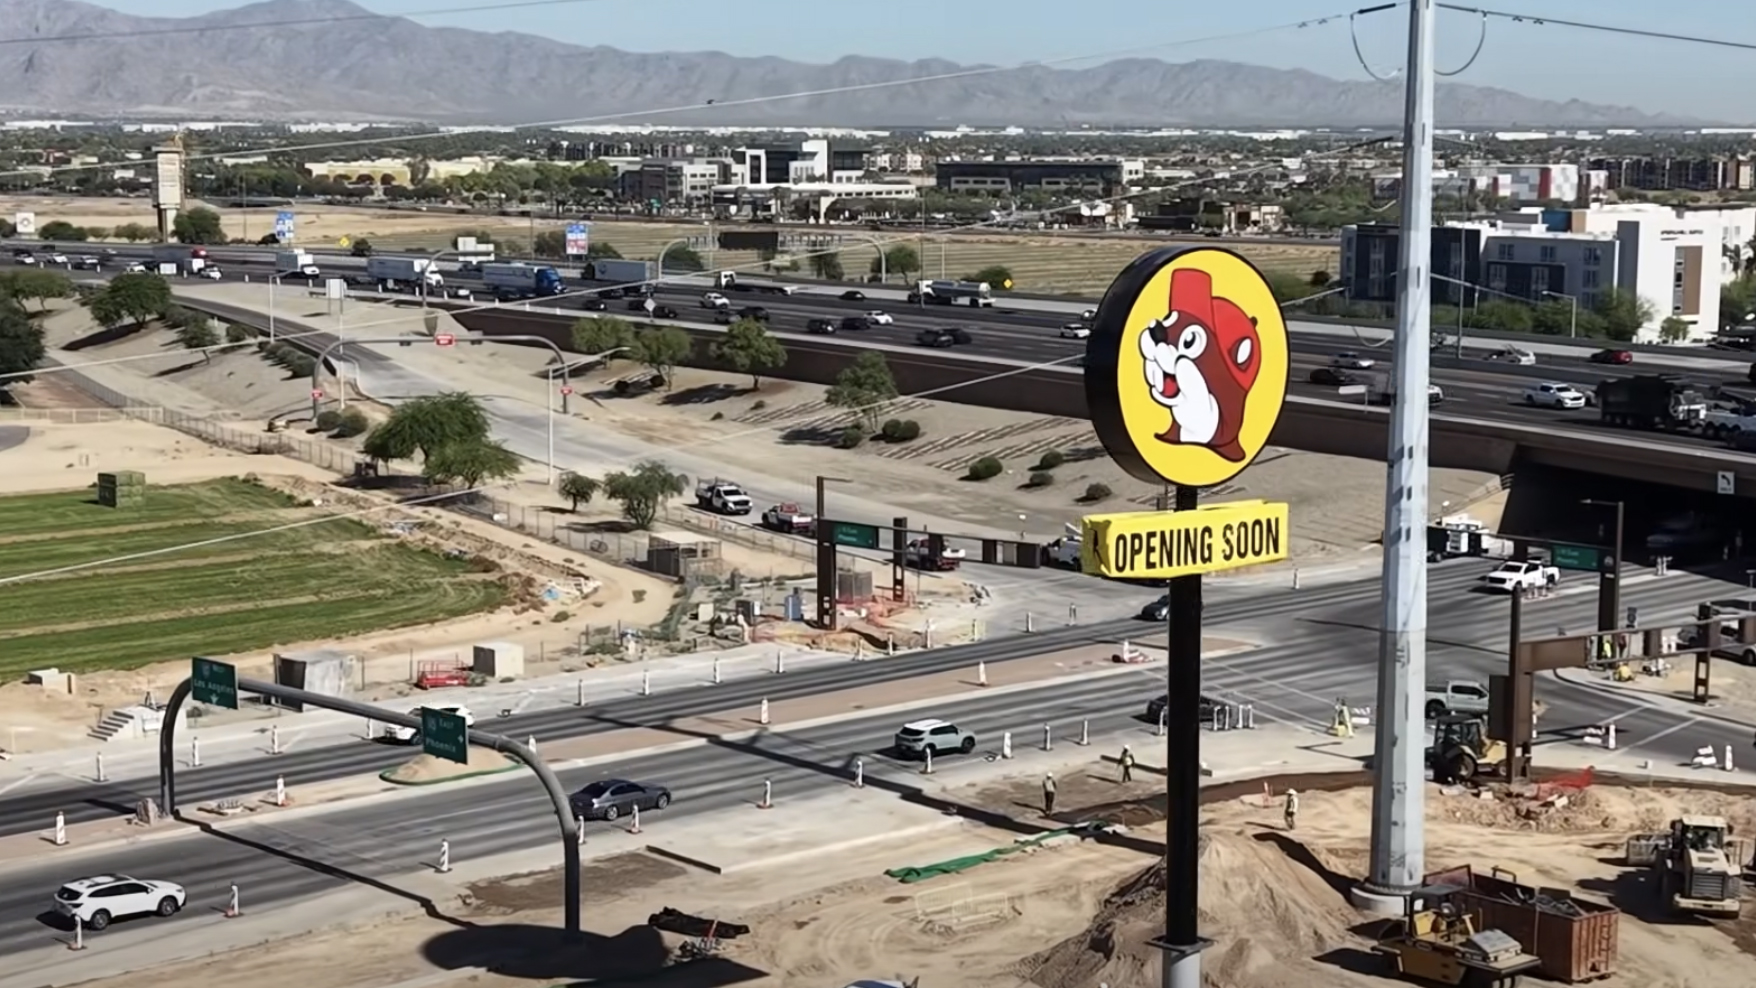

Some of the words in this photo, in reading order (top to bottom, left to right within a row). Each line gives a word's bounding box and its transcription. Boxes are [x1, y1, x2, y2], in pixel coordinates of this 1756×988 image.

[1115, 525, 1213, 573] OPENING
[1222, 517, 1280, 562] SOON
[194, 679, 206, 689] Los
[208, 681, 235, 695] Angeles
[425, 737, 456, 753] Phoenix
